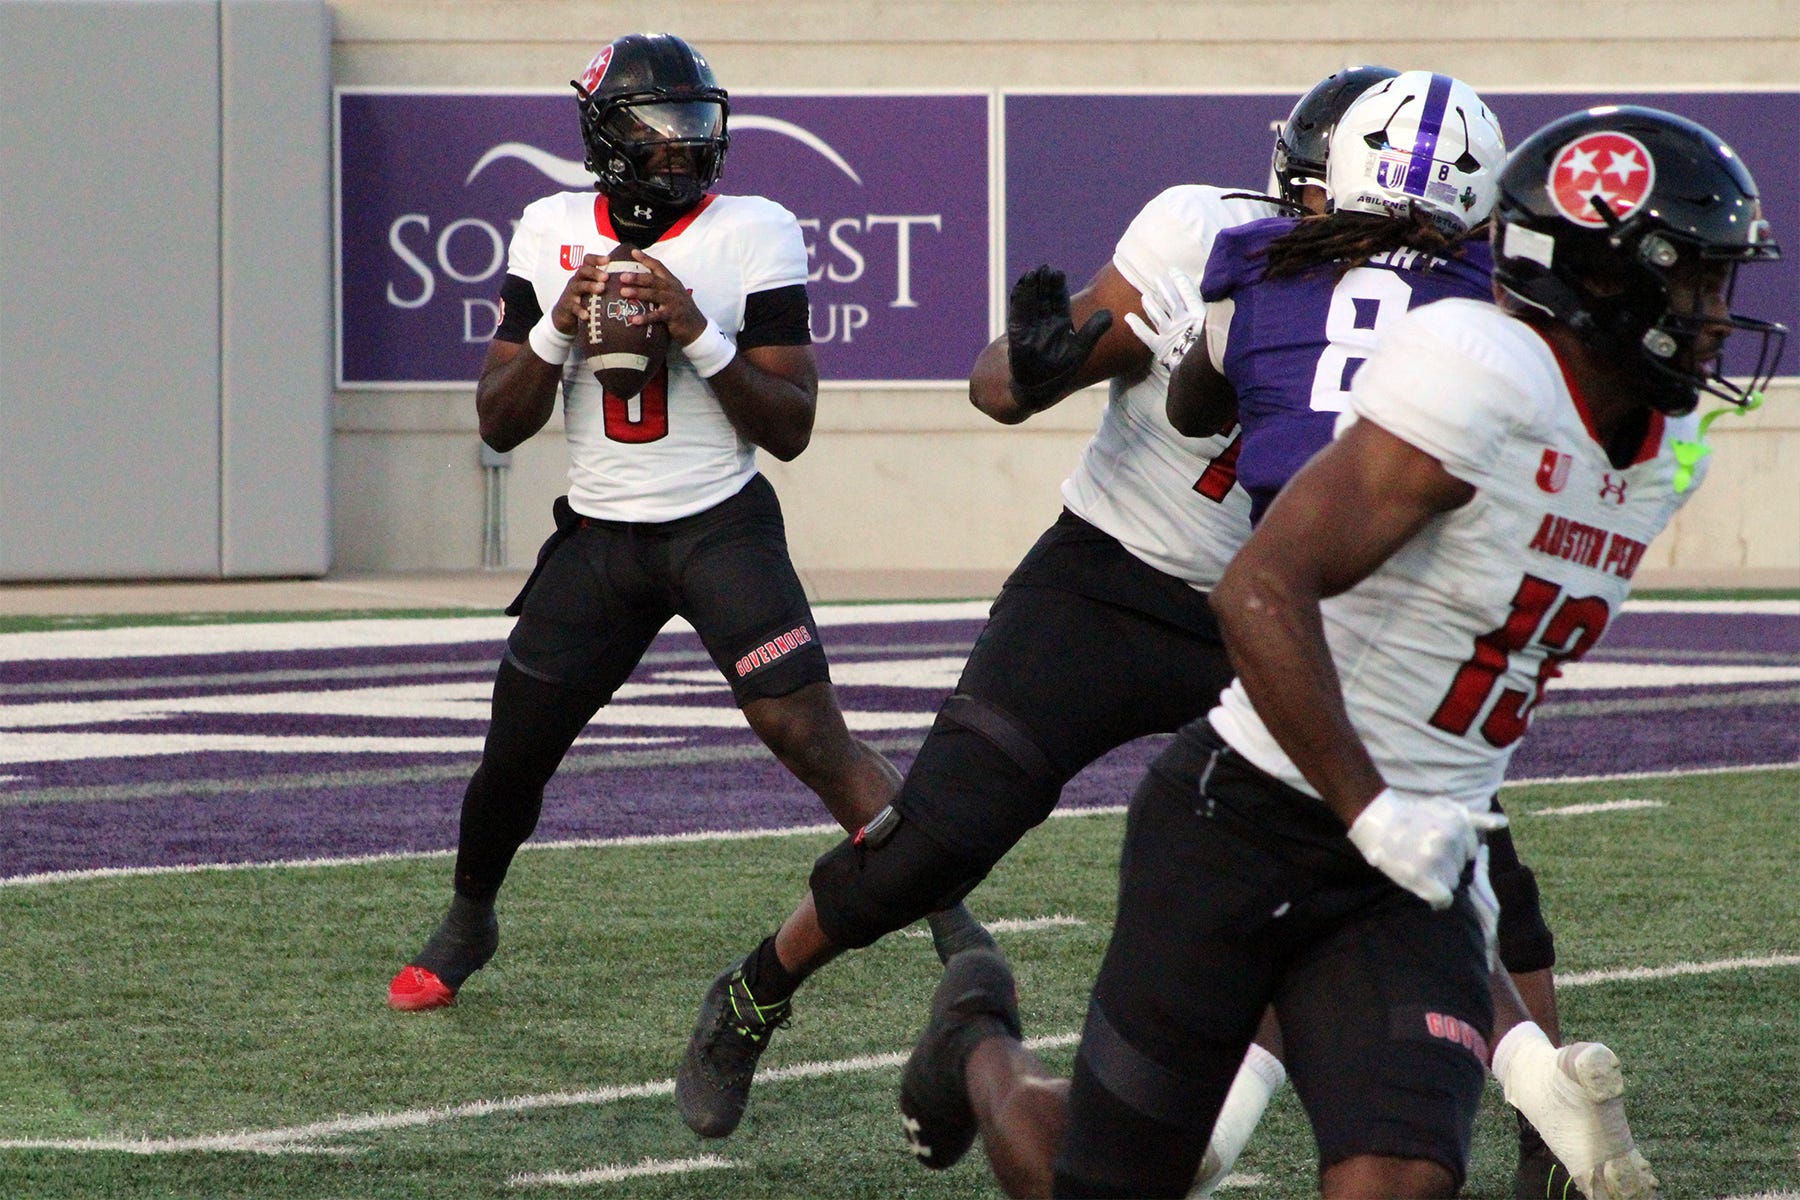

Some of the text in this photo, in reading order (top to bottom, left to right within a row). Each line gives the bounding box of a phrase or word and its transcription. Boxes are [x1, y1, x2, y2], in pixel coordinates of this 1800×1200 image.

[1438, 164, 1450, 181] 8
[1356, 195, 1407, 212] ABILENE
[1309, 267, 1413, 413] 8
[1529, 513, 1608, 569] AUSTIN
[736, 625, 812, 677] GOVERNORS
[1429, 573, 1610, 748] 13
